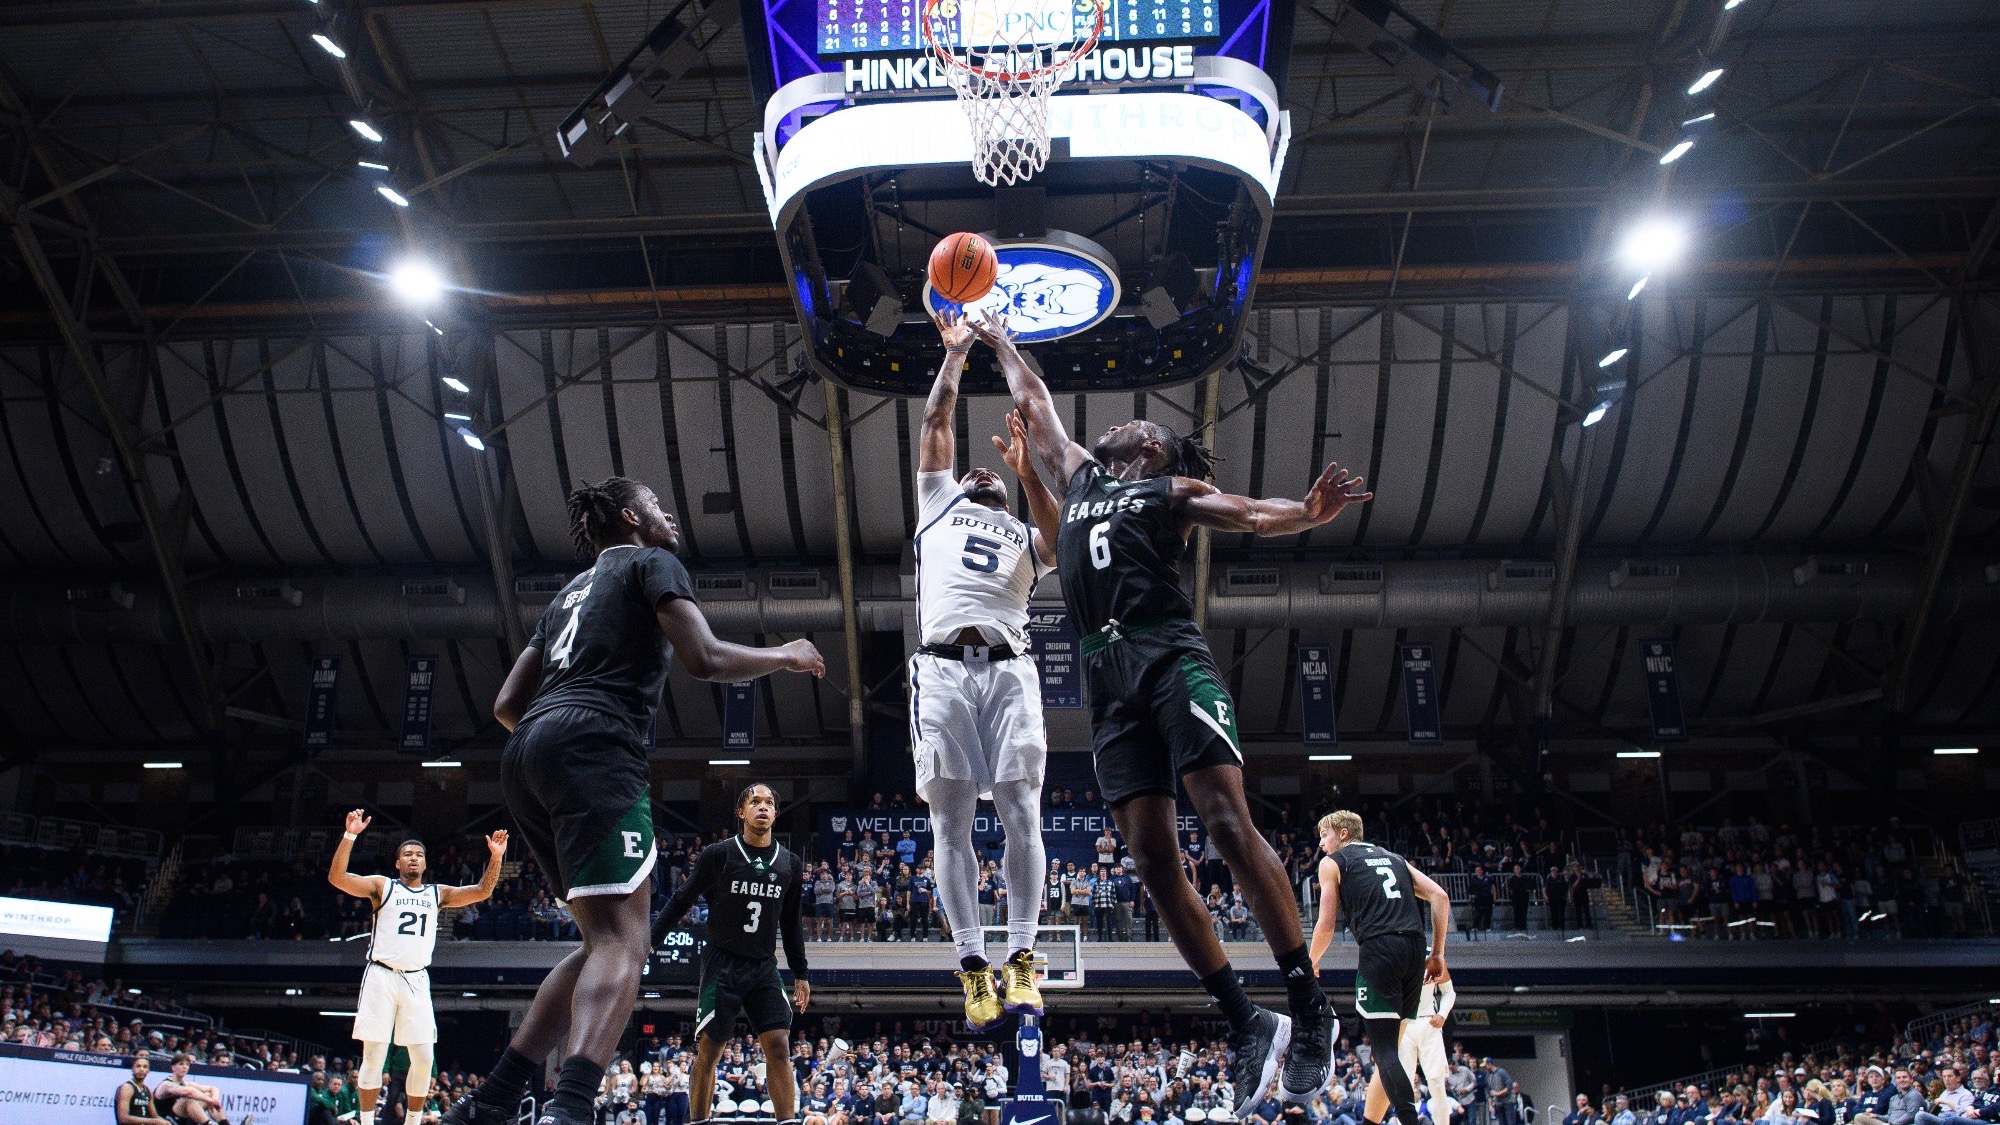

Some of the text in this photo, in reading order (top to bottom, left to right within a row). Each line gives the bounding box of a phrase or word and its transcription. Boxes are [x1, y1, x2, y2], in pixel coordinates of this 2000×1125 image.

[855, 8, 864, 19] 7
[880, 7, 888, 18] 1
[901, 5, 910, 17] 0
[1152, 8, 1166, 20] 11
[1182, 7, 1190, 19] 2
[1203, 6, 1212, 18] 0
[826, 23, 839, 35] 11
[852, 21, 868, 34] 12
[880, 20, 889, 33] 2
[901, 19, 910, 31] 2
[1004, 10, 1065, 33] PNC
[1129, 20, 1213, 35] 6 0 3 0
[825, 38, 840, 50] 21
[852, 36, 868, 48] 13
[901, 34, 910, 46] 2
[845, 45, 1194, 92] HINKLE FIELDHOUSE
[960, 237, 980, 271] ELITE
[1067, 496, 1146, 524] EAGLES
[950, 516, 1024, 551] BUTLER
[962, 535, 1002, 573] 5
[1089, 521, 1112, 570] 6
[1029, 614, 1066, 624] AST
[551, 604, 582, 669] 4
[1045, 654, 1073, 662] MARQUETTE
[313, 669, 337, 683] AIAW
[1302, 661, 1328, 675] NCAA
[410, 672, 432, 685] WNIT
[1214, 700, 1231, 726] E
[856, 815, 1199, 832] WELCO O HLE FIELSE
[621, 830, 644, 858] E
[730, 880, 782, 899] EAGLES
[1375, 866, 1402, 899] 2
[395, 898, 432, 910] BUTLER
[4, 912, 71, 924] WINTHROP
[398, 911, 428, 938] 21
[743, 901, 762, 933] 3
[671, 949, 679, 960] 2
[1357, 987, 1367, 1001] E
[0, 1090, 115, 1108] COMMITTED TO EXCELL
[221, 1094, 277, 1113] INTHROP
[1017, 1094, 1044, 1102] BUTLER
